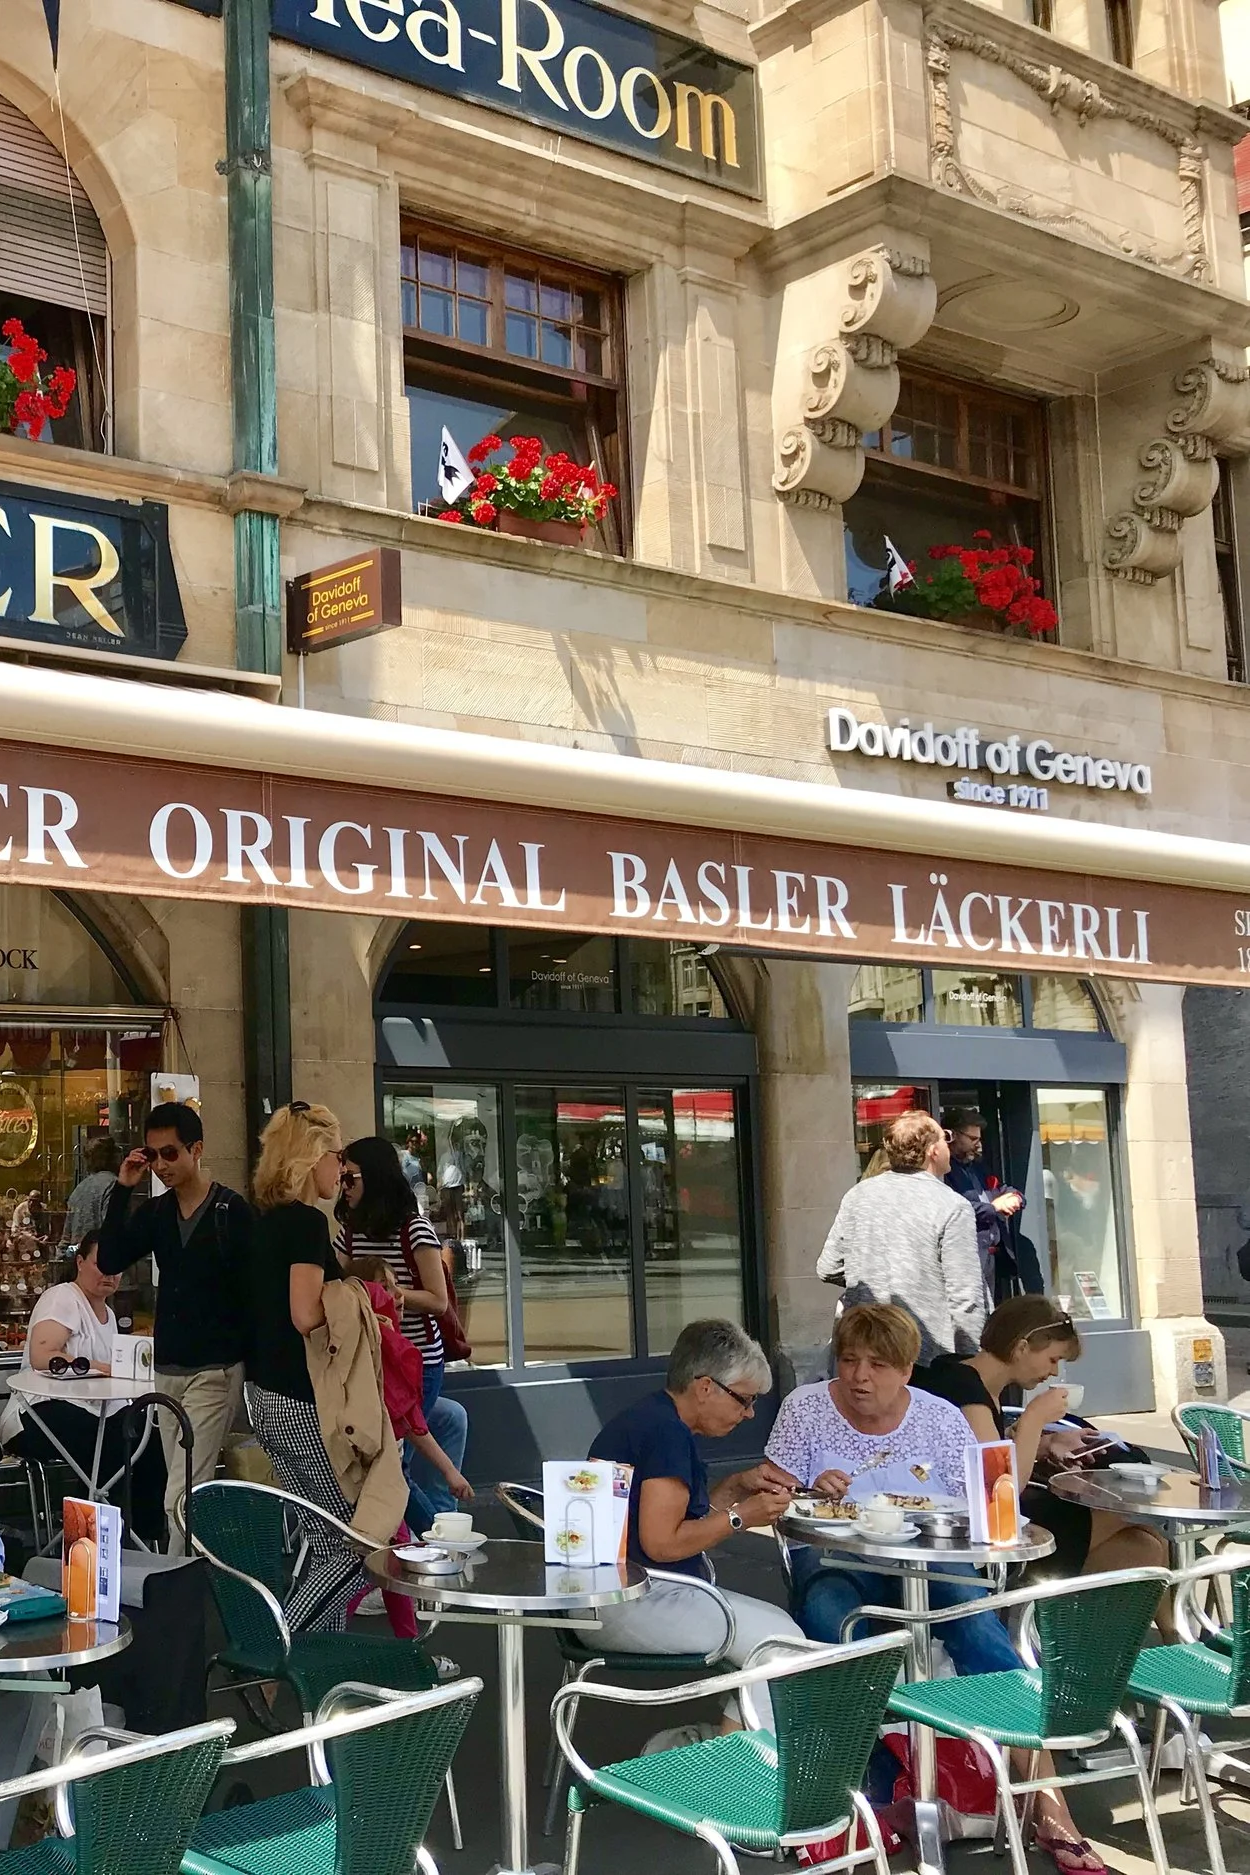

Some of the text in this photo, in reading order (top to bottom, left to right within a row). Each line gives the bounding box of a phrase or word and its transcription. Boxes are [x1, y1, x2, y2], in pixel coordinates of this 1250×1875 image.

[309, 0, 740, 168] ea-Room
[312, 576, 361, 606] Davidoff
[306, 592, 369, 624] of Geneva
[325, 621, 338, 631] since
[828, 707, 1152, 794] Davidoff of Geneva
[953, 776, 1048, 811] since 1911
[149, 802, 566, 912] ORIGINAL
[606, 850, 857, 939] BASLER
[887, 872, 1152, 965] LÄCKERLI
[531, 970, 609, 984] Davidoff of Geneva
